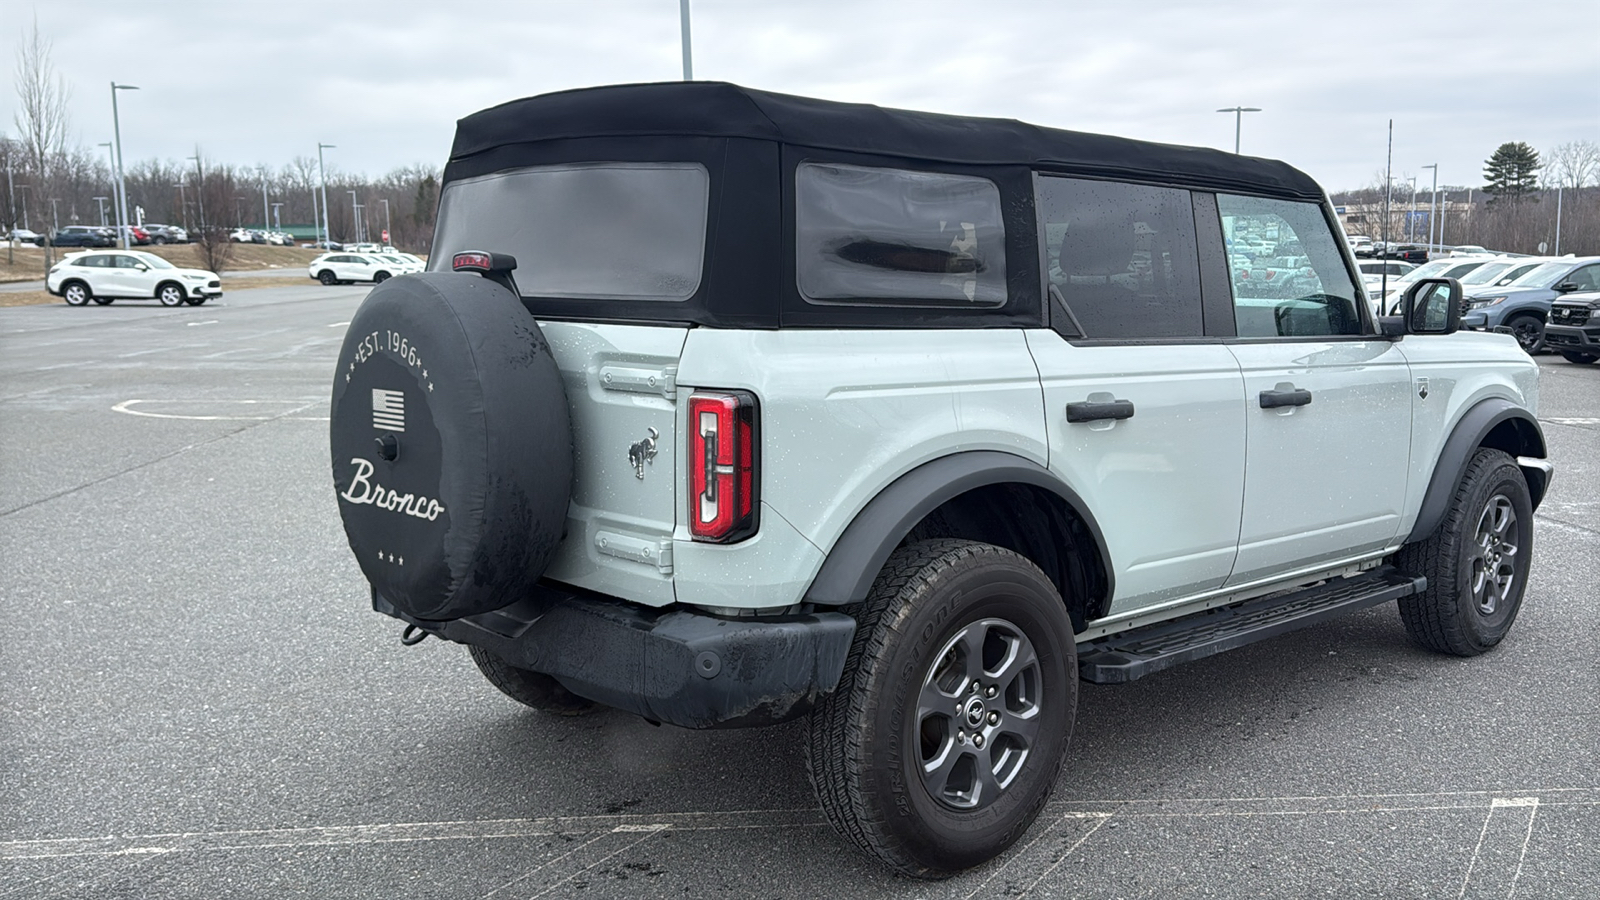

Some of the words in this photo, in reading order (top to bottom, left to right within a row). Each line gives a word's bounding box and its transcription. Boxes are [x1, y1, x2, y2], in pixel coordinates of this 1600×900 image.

[358, 331, 383, 363] EST.
[387, 330, 416, 367] 1966
[341, 457, 445, 521] Bronco
